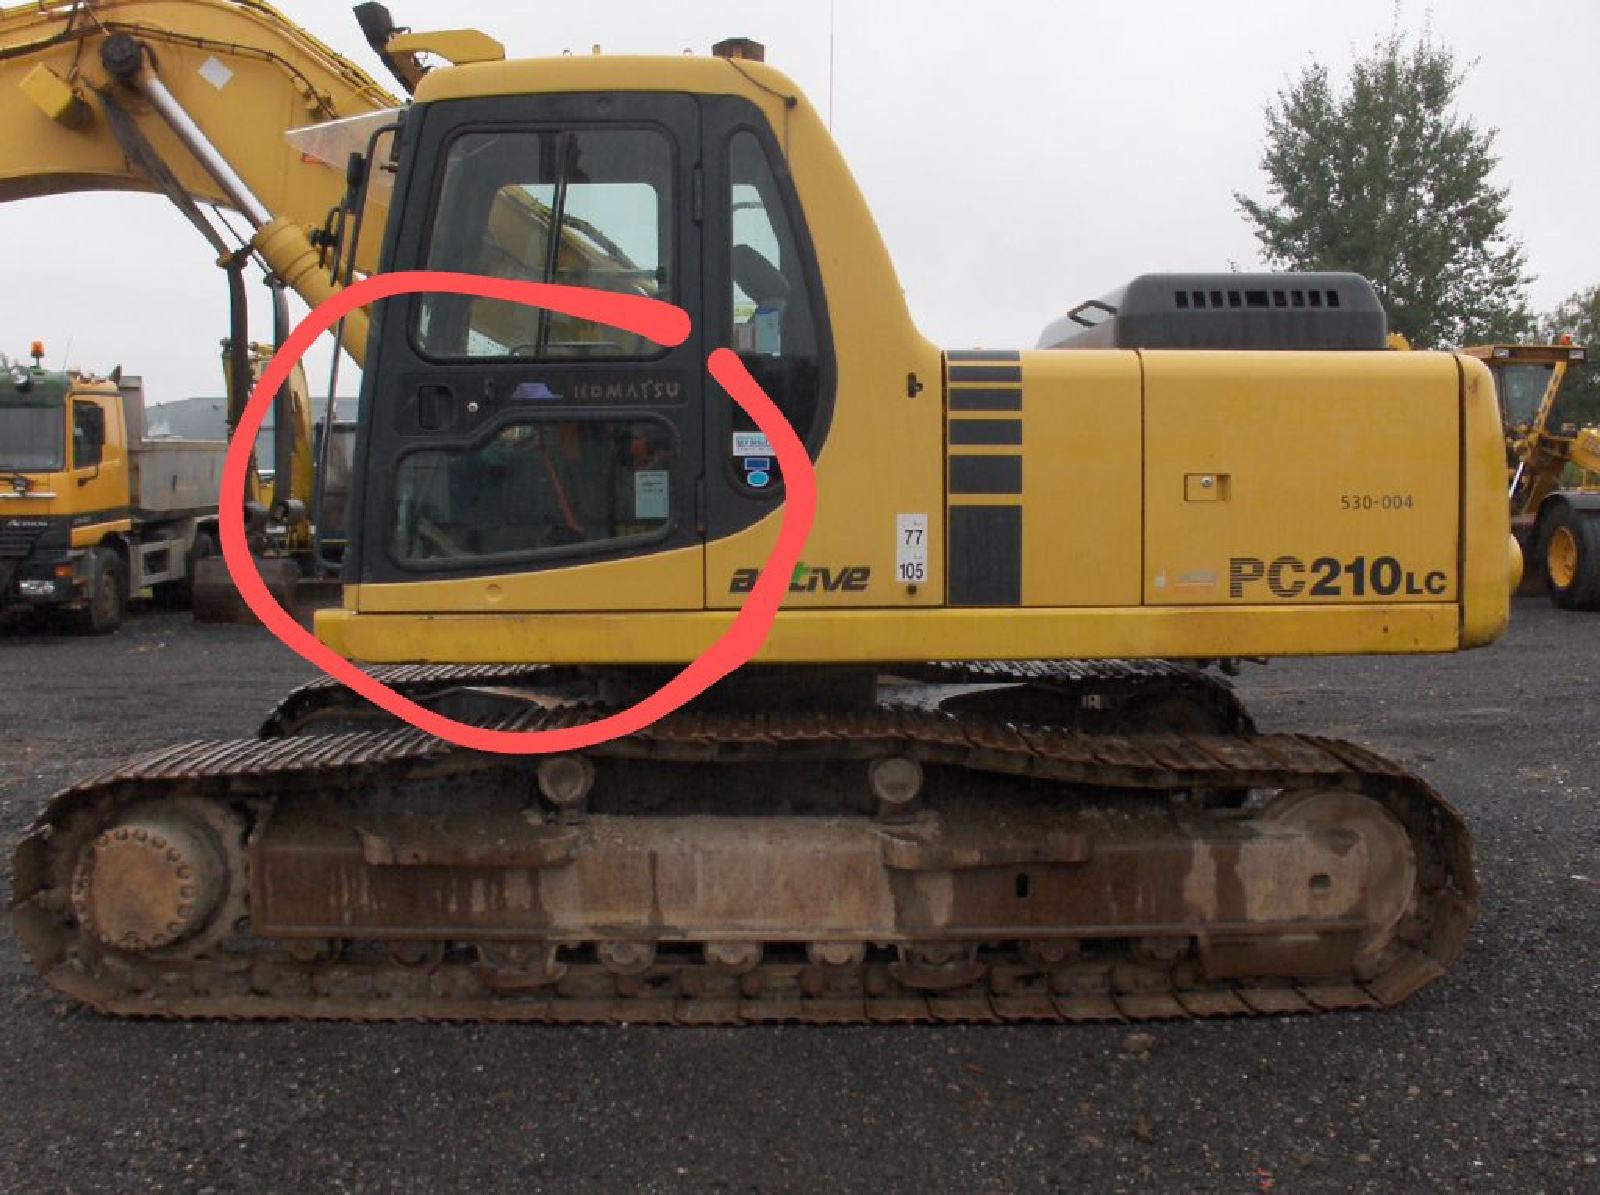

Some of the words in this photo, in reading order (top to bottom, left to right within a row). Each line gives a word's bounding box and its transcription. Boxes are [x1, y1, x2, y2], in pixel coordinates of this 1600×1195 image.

[574, 380, 681, 399] KOMATSU
[1340, 494, 1414, 511] 530-004
[904, 529, 923, 545] 77
[729, 561, 871, 593] ative
[899, 563, 924, 579] 105
